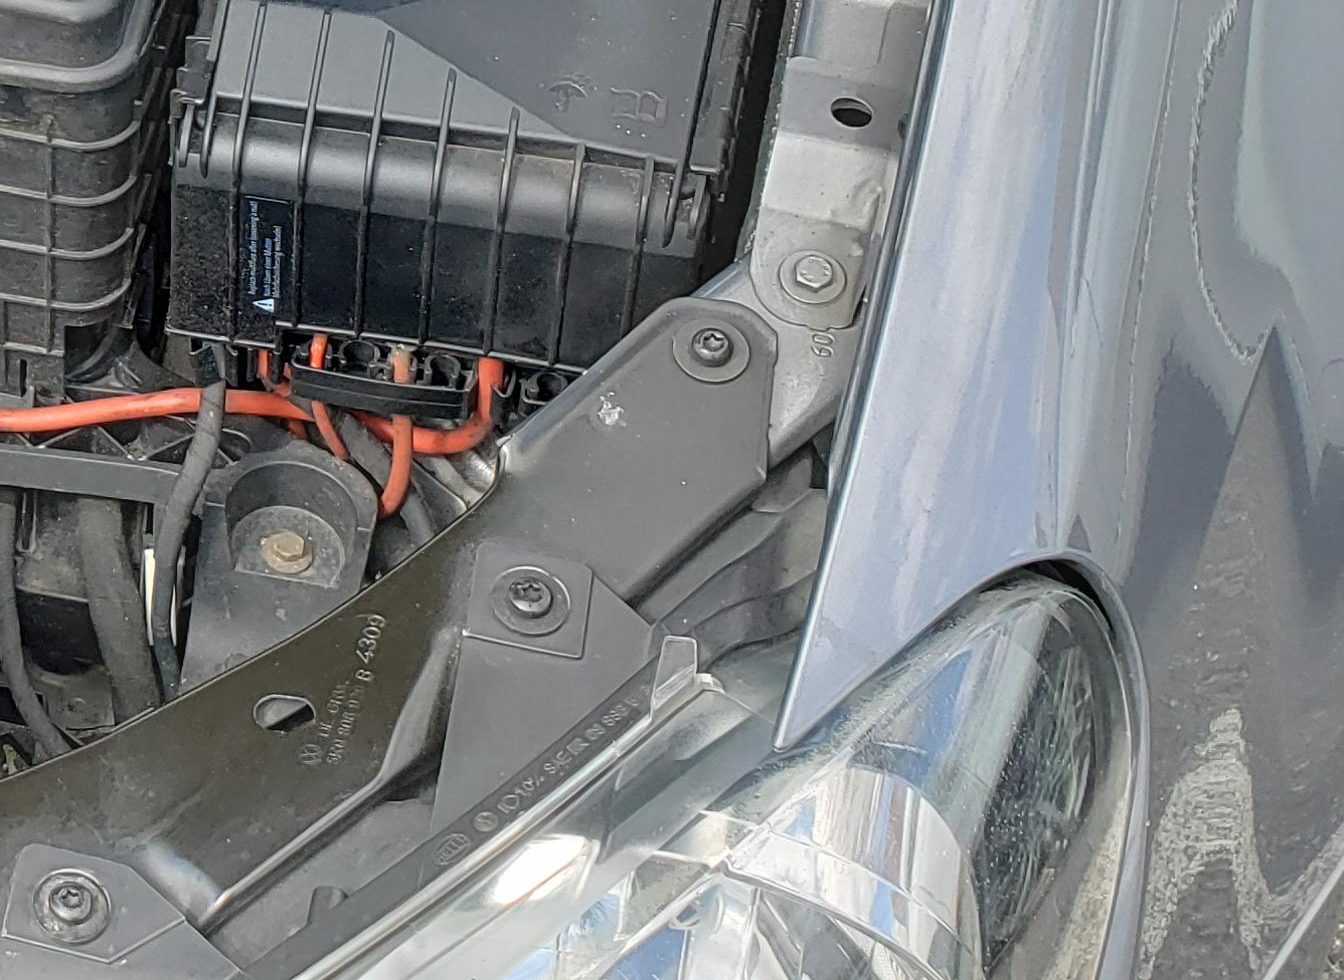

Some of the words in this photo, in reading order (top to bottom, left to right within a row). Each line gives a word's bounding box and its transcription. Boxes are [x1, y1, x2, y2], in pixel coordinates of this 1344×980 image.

[811, 331, 836, 358] 60
[355, 614, 386, 664] 4309
[354, 668, 375, 684] B
